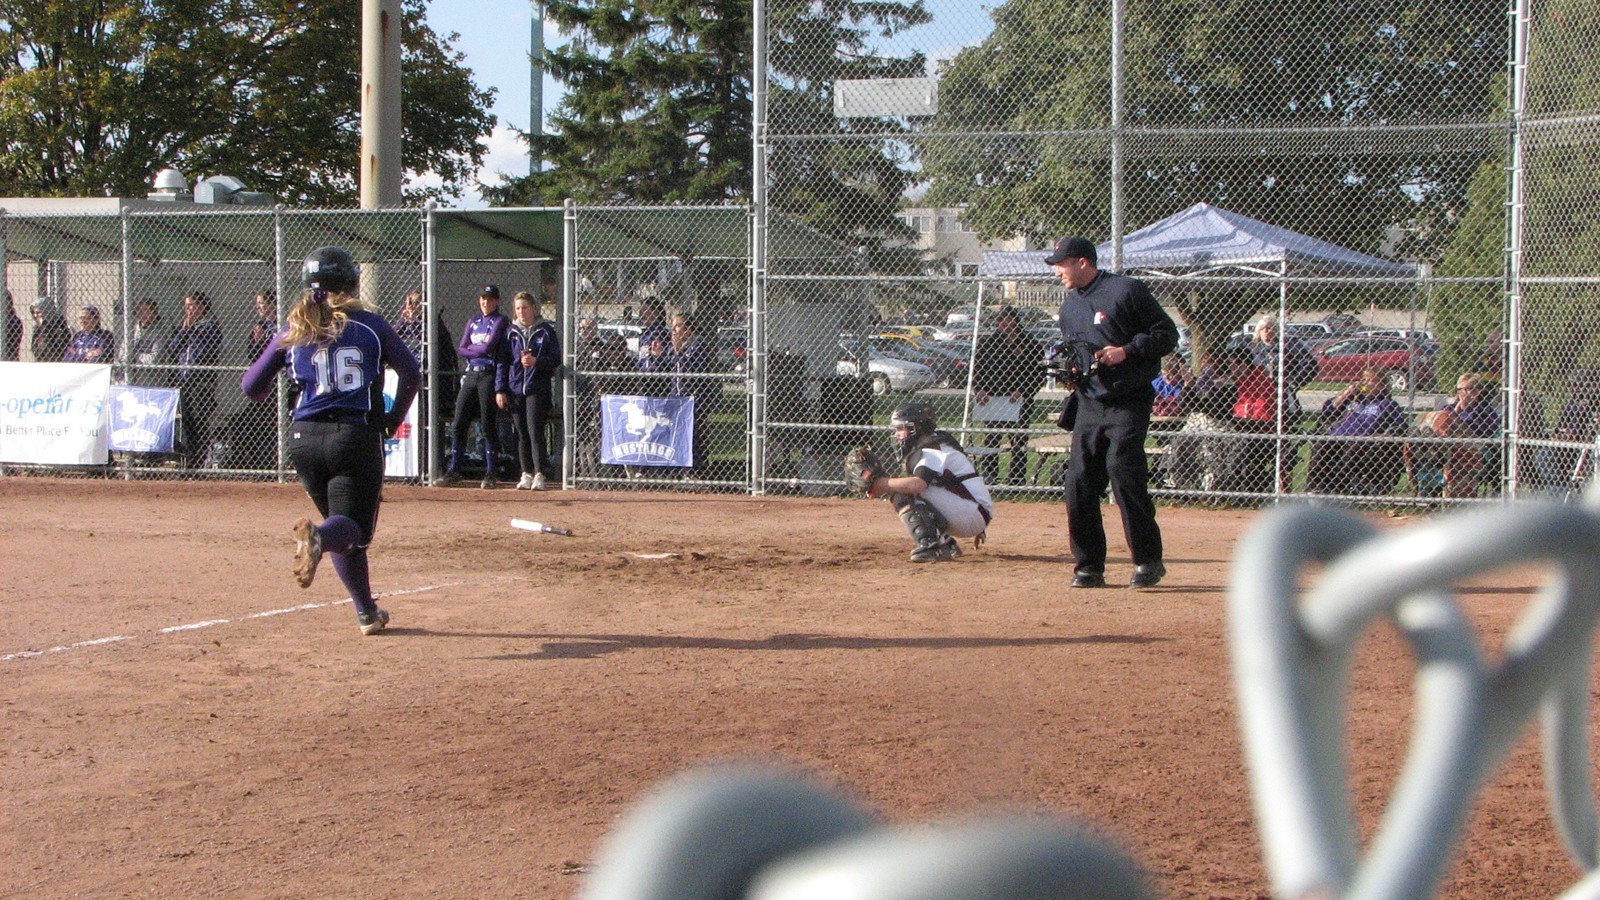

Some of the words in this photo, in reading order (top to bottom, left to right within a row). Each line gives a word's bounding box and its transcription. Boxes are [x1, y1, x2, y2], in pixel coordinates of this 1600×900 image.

[311, 347, 364, 395] 16
[37, 426, 61, 436] Place
[614, 442, 674, 459] MUSTANGS
